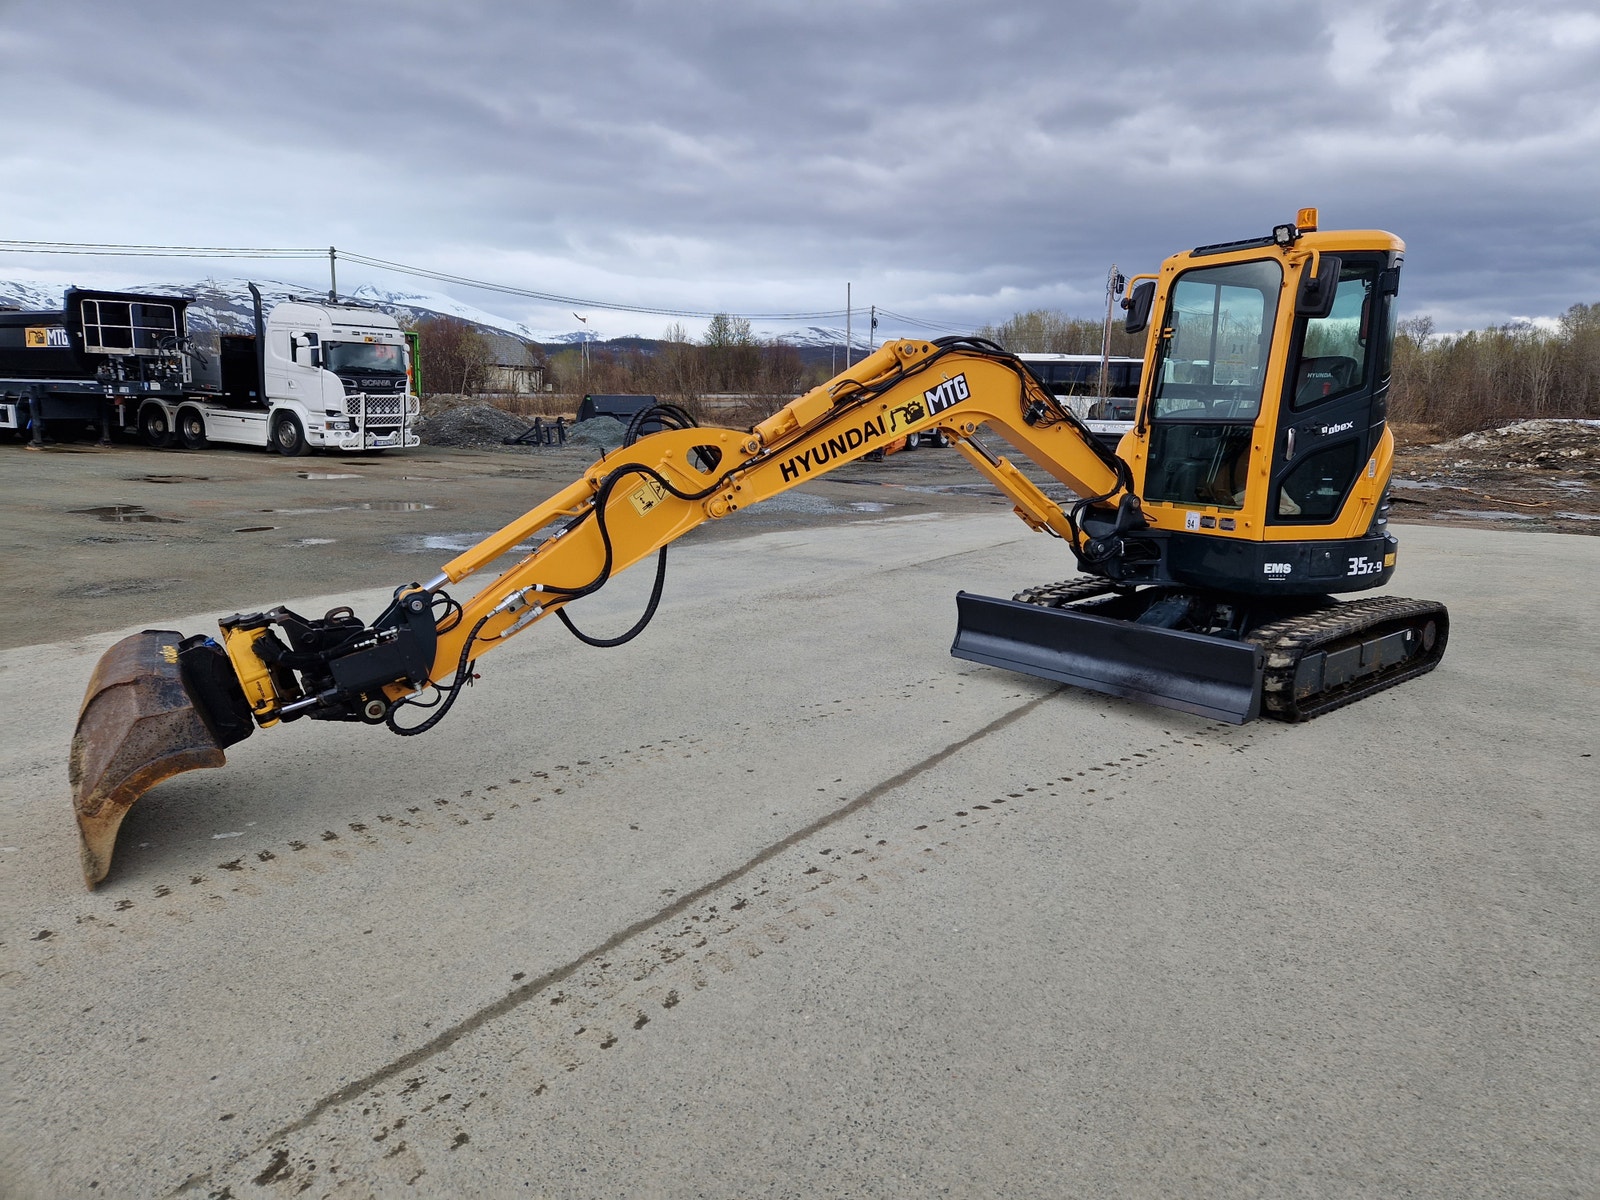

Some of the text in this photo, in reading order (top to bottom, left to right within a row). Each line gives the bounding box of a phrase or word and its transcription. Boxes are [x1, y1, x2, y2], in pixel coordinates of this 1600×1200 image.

[46, 329, 69, 346] MTG
[925, 374, 970, 415] MTG
[779, 415, 887, 483] HYUNDAI
[1263, 563, 1292, 574] EMS
